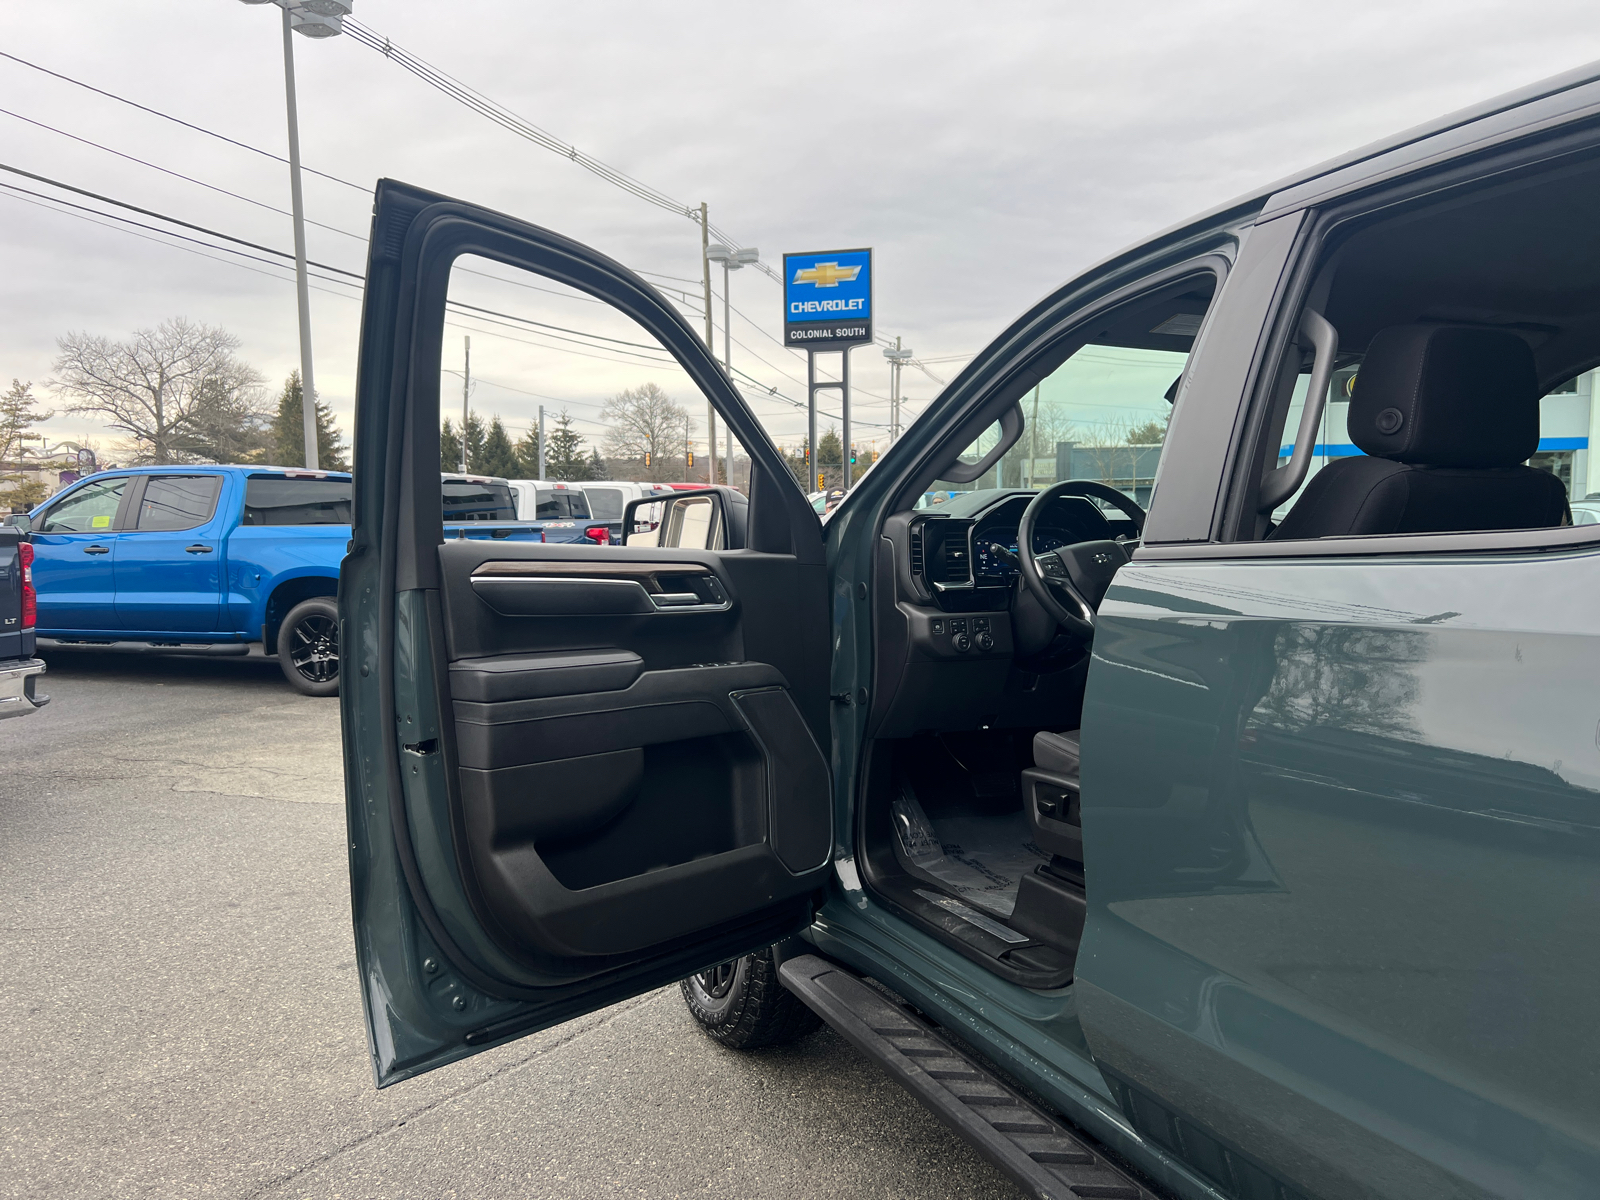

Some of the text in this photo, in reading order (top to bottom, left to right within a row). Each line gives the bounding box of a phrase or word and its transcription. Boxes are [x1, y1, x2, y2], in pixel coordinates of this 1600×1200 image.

[791, 298, 865, 313] CHEVROLET
[790, 327, 866, 339] COLONIAL SOUTH
[4, 617, 17, 625] LT
